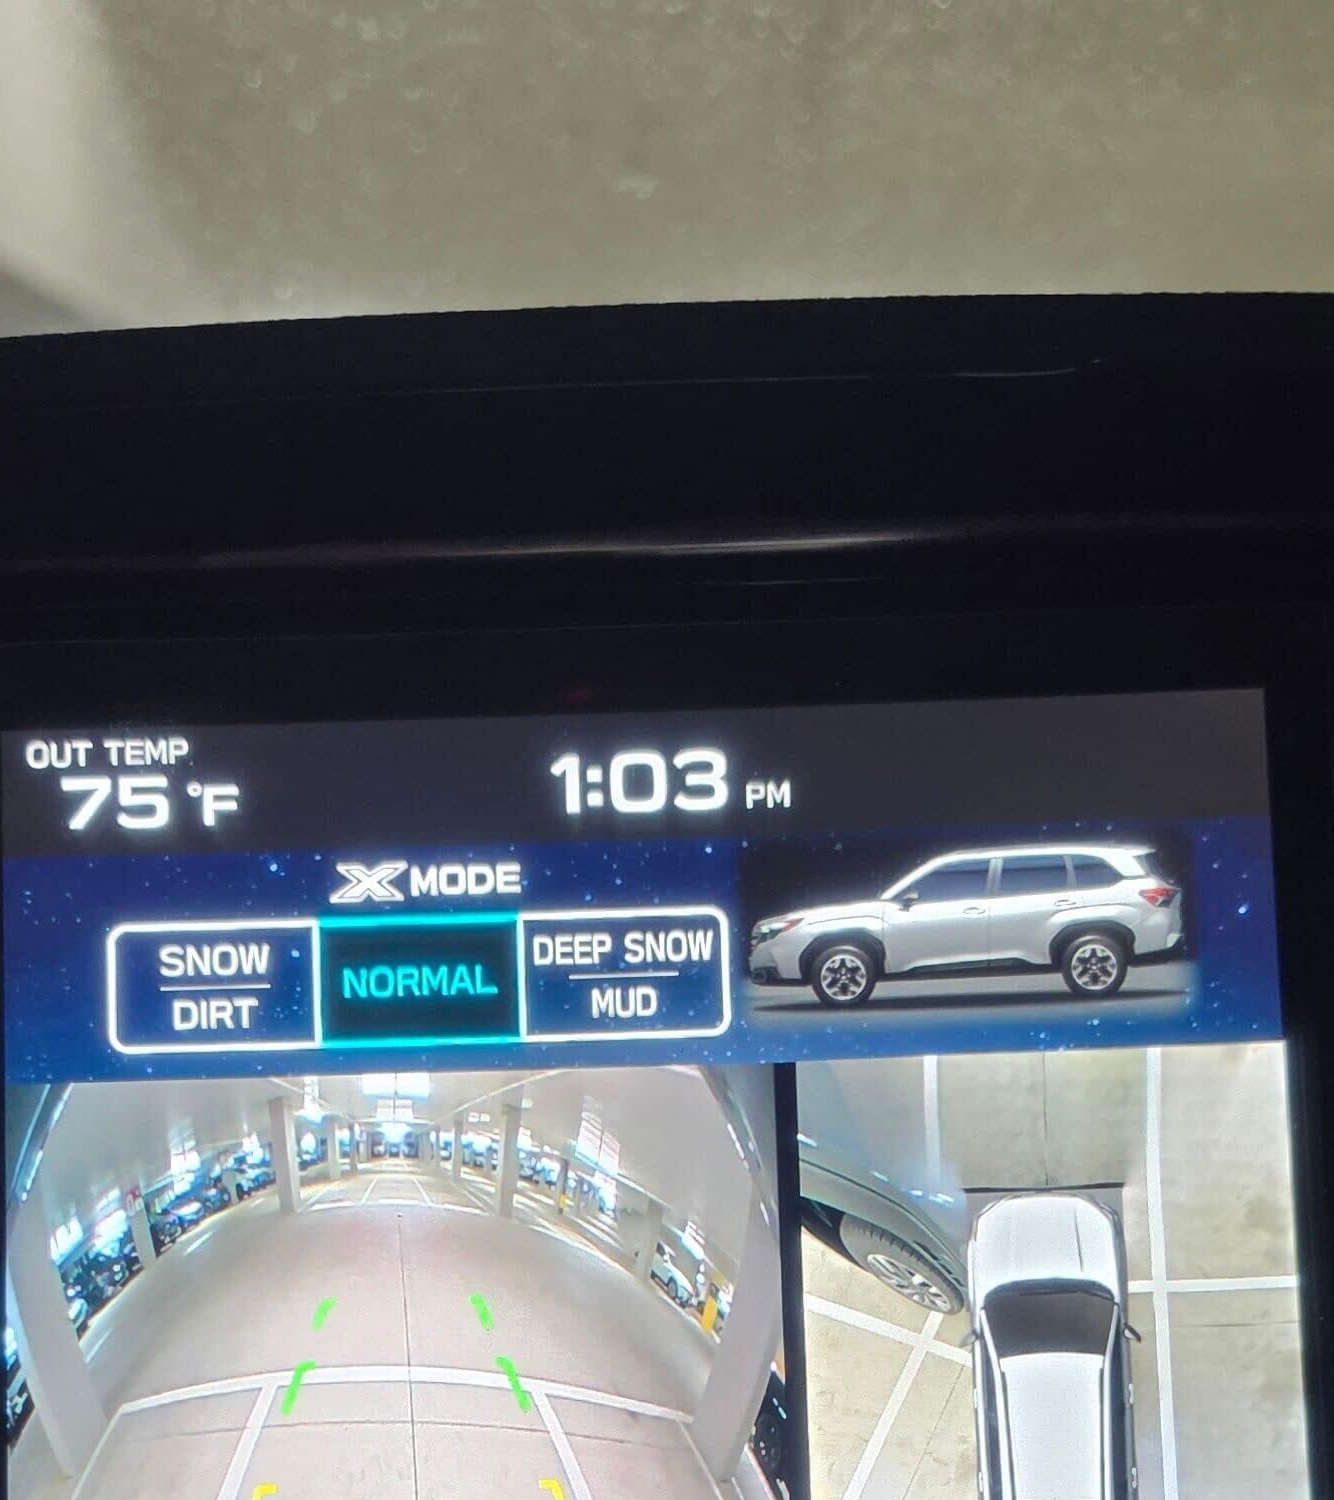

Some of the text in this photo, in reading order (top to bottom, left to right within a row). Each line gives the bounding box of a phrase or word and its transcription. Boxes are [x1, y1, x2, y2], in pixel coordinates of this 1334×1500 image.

[24, 736, 189, 770] OUT TEMP
[550, 747, 791, 816] 1:03 PM
[59, 775, 169, 832] 75
[157, 944, 269, 978] SNOW
[532, 929, 713, 966] DEEP SNOW
[341, 963, 499, 1000] NORMAL
[171, 999, 261, 1032] DIRT
[591, 986, 659, 1019] MUD
